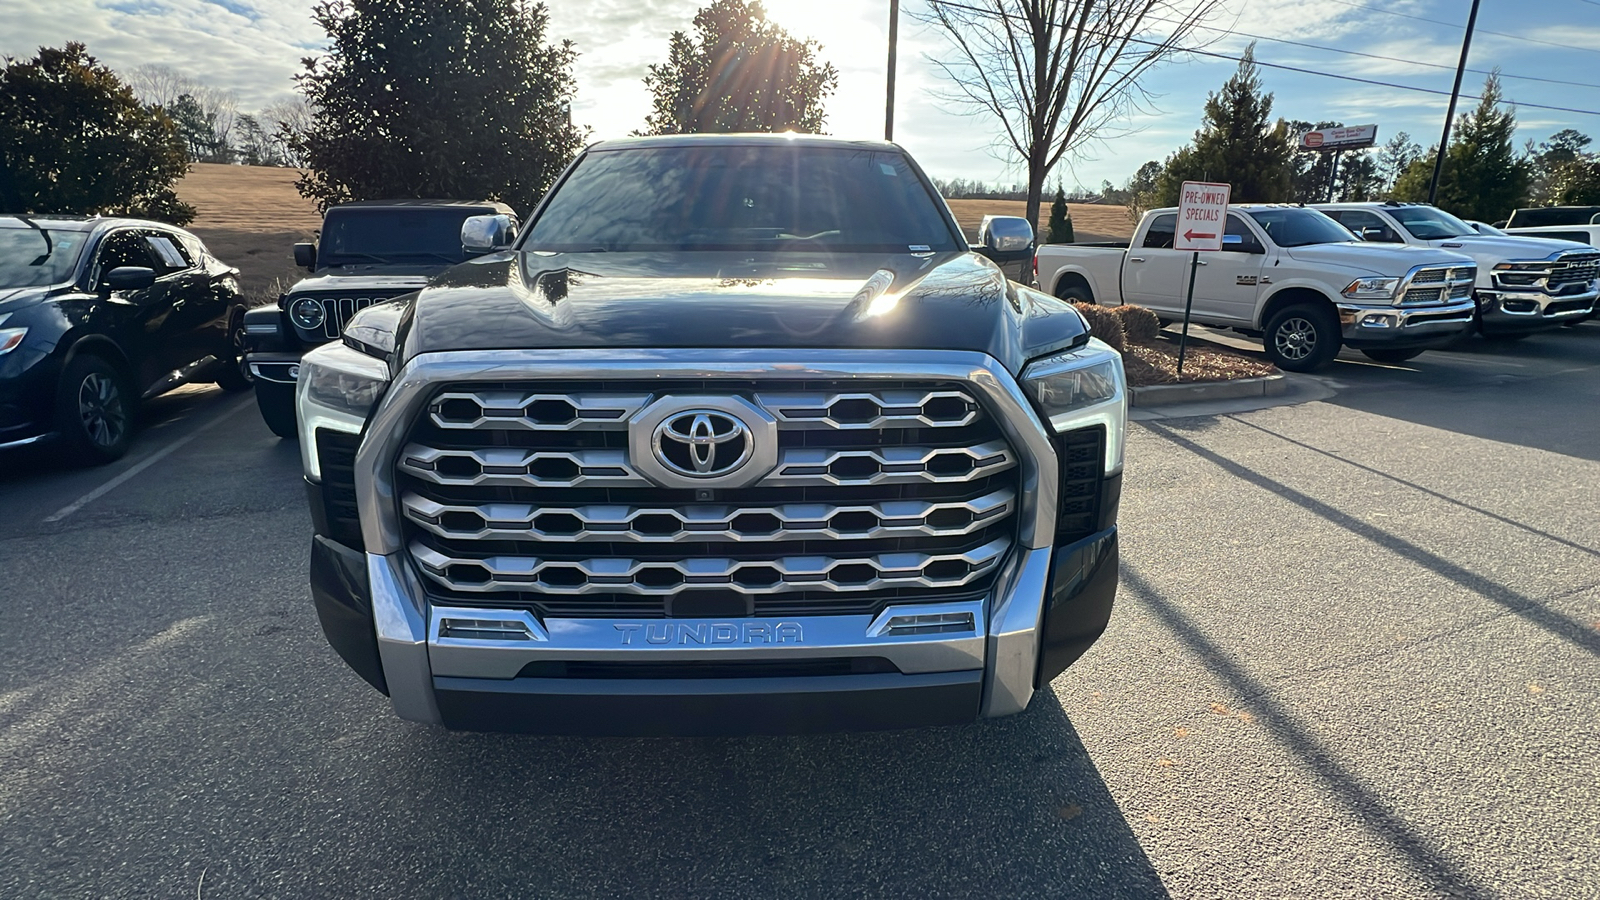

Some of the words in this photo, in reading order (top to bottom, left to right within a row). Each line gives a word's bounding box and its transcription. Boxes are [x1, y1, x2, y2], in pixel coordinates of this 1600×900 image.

[1184, 191, 1225, 205] PRE-OWNED
[1185, 208, 1219, 221] SPECIALS
[613, 622, 804, 645] TUNDRA
